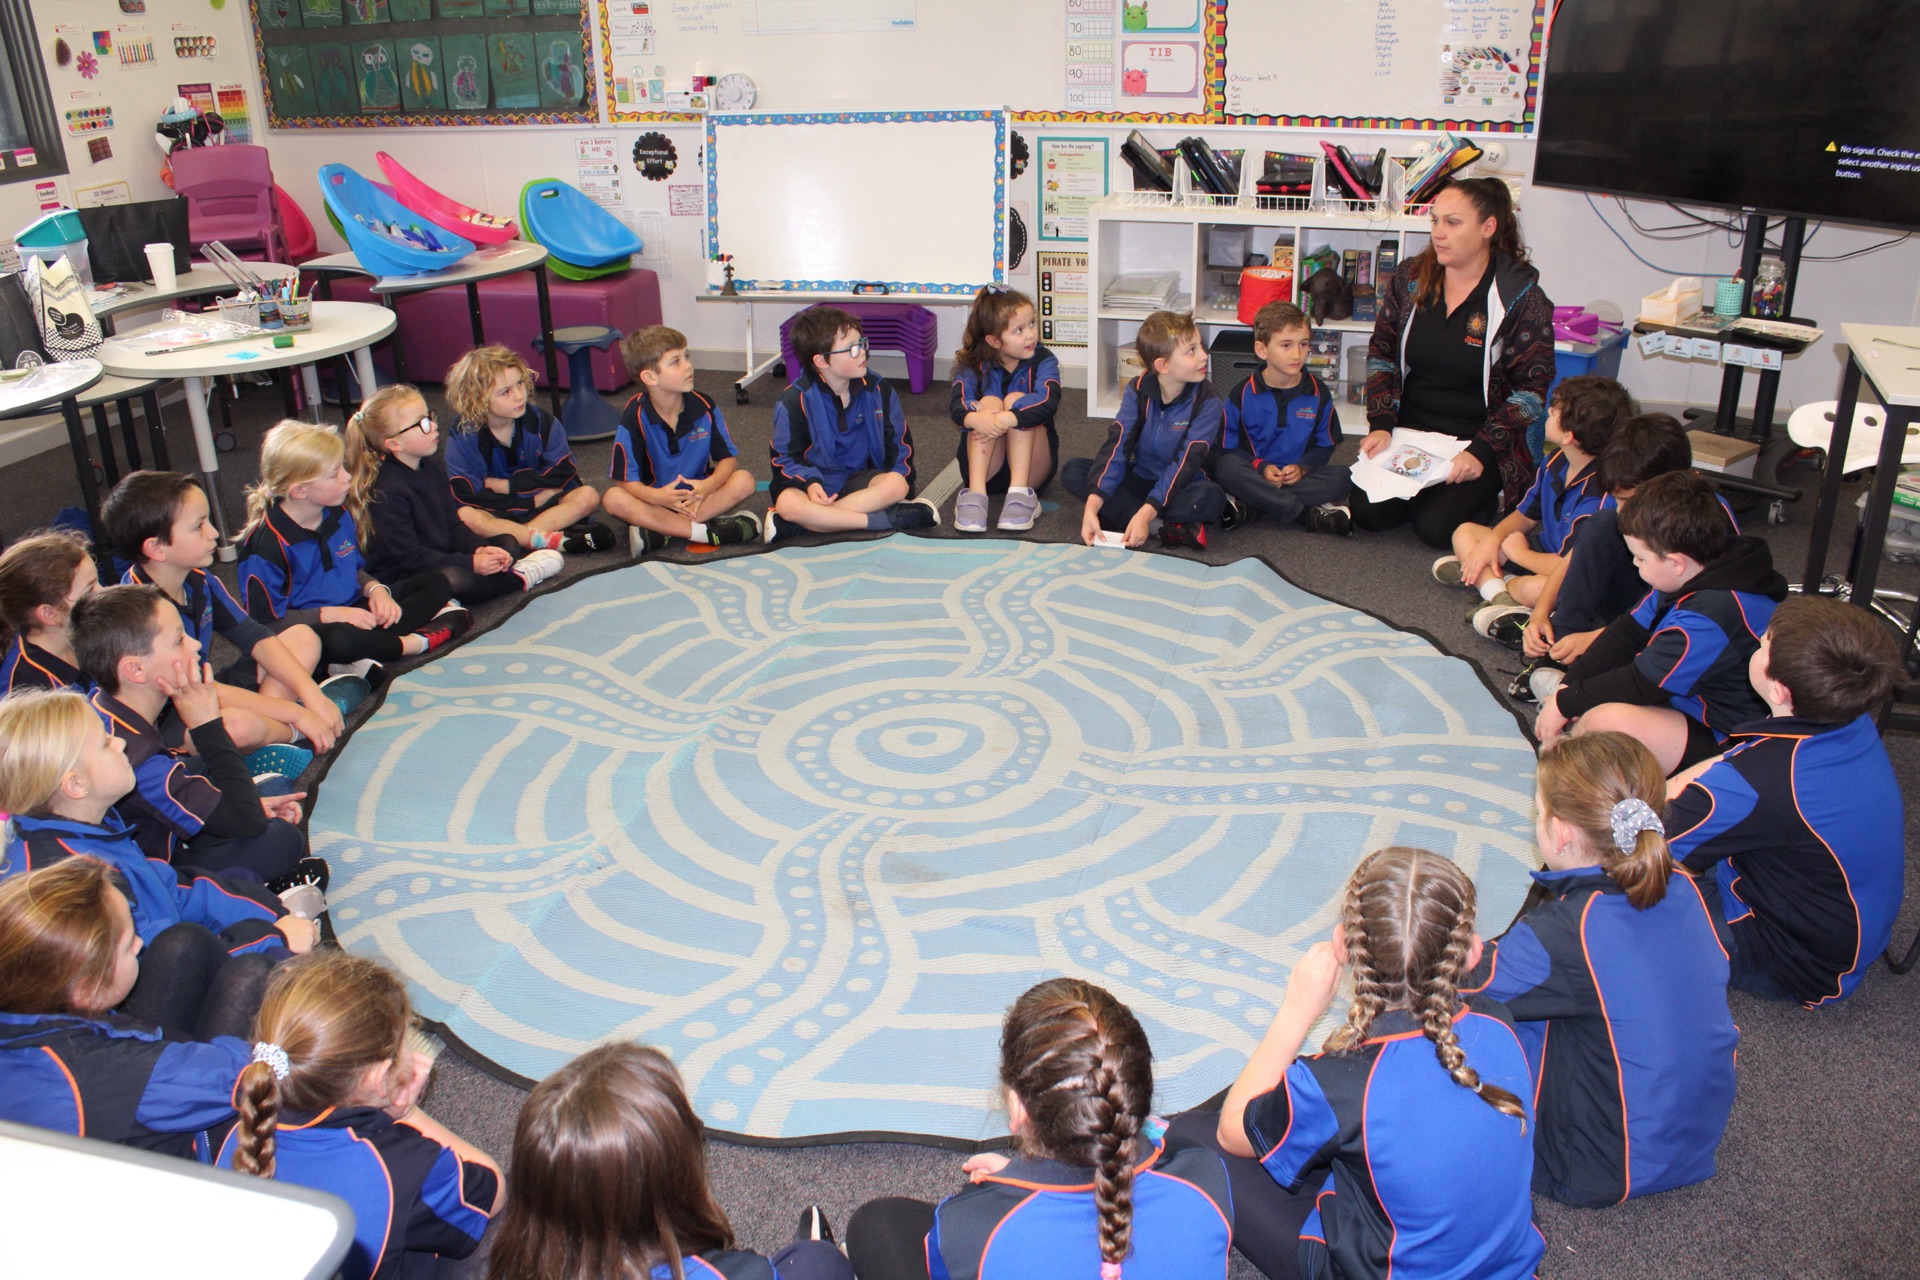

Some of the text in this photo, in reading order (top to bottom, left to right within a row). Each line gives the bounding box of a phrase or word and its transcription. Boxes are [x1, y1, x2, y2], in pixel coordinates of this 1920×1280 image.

[671, 3, 689, 13] Zones
[1070, 23, 1082, 33] 70
[1069, 45, 1081, 56] 80
[1149, 47, 1171, 56] TIB
[1069, 68, 1082, 79] 90
[1069, 94, 1083, 102] 100
[1840, 145, 1851, 153] No
[1852, 147, 1875, 156] signal.
[1877, 148, 1899, 157] Check
[1900, 150, 1914, 158] the
[1838, 158, 1859, 166] select
[1860, 160, 1889, 169] another
[1890, 162, 1911, 171] input
[1835, 169, 1862, 179] button.
[1043, 257, 1071, 266] PIRATE
